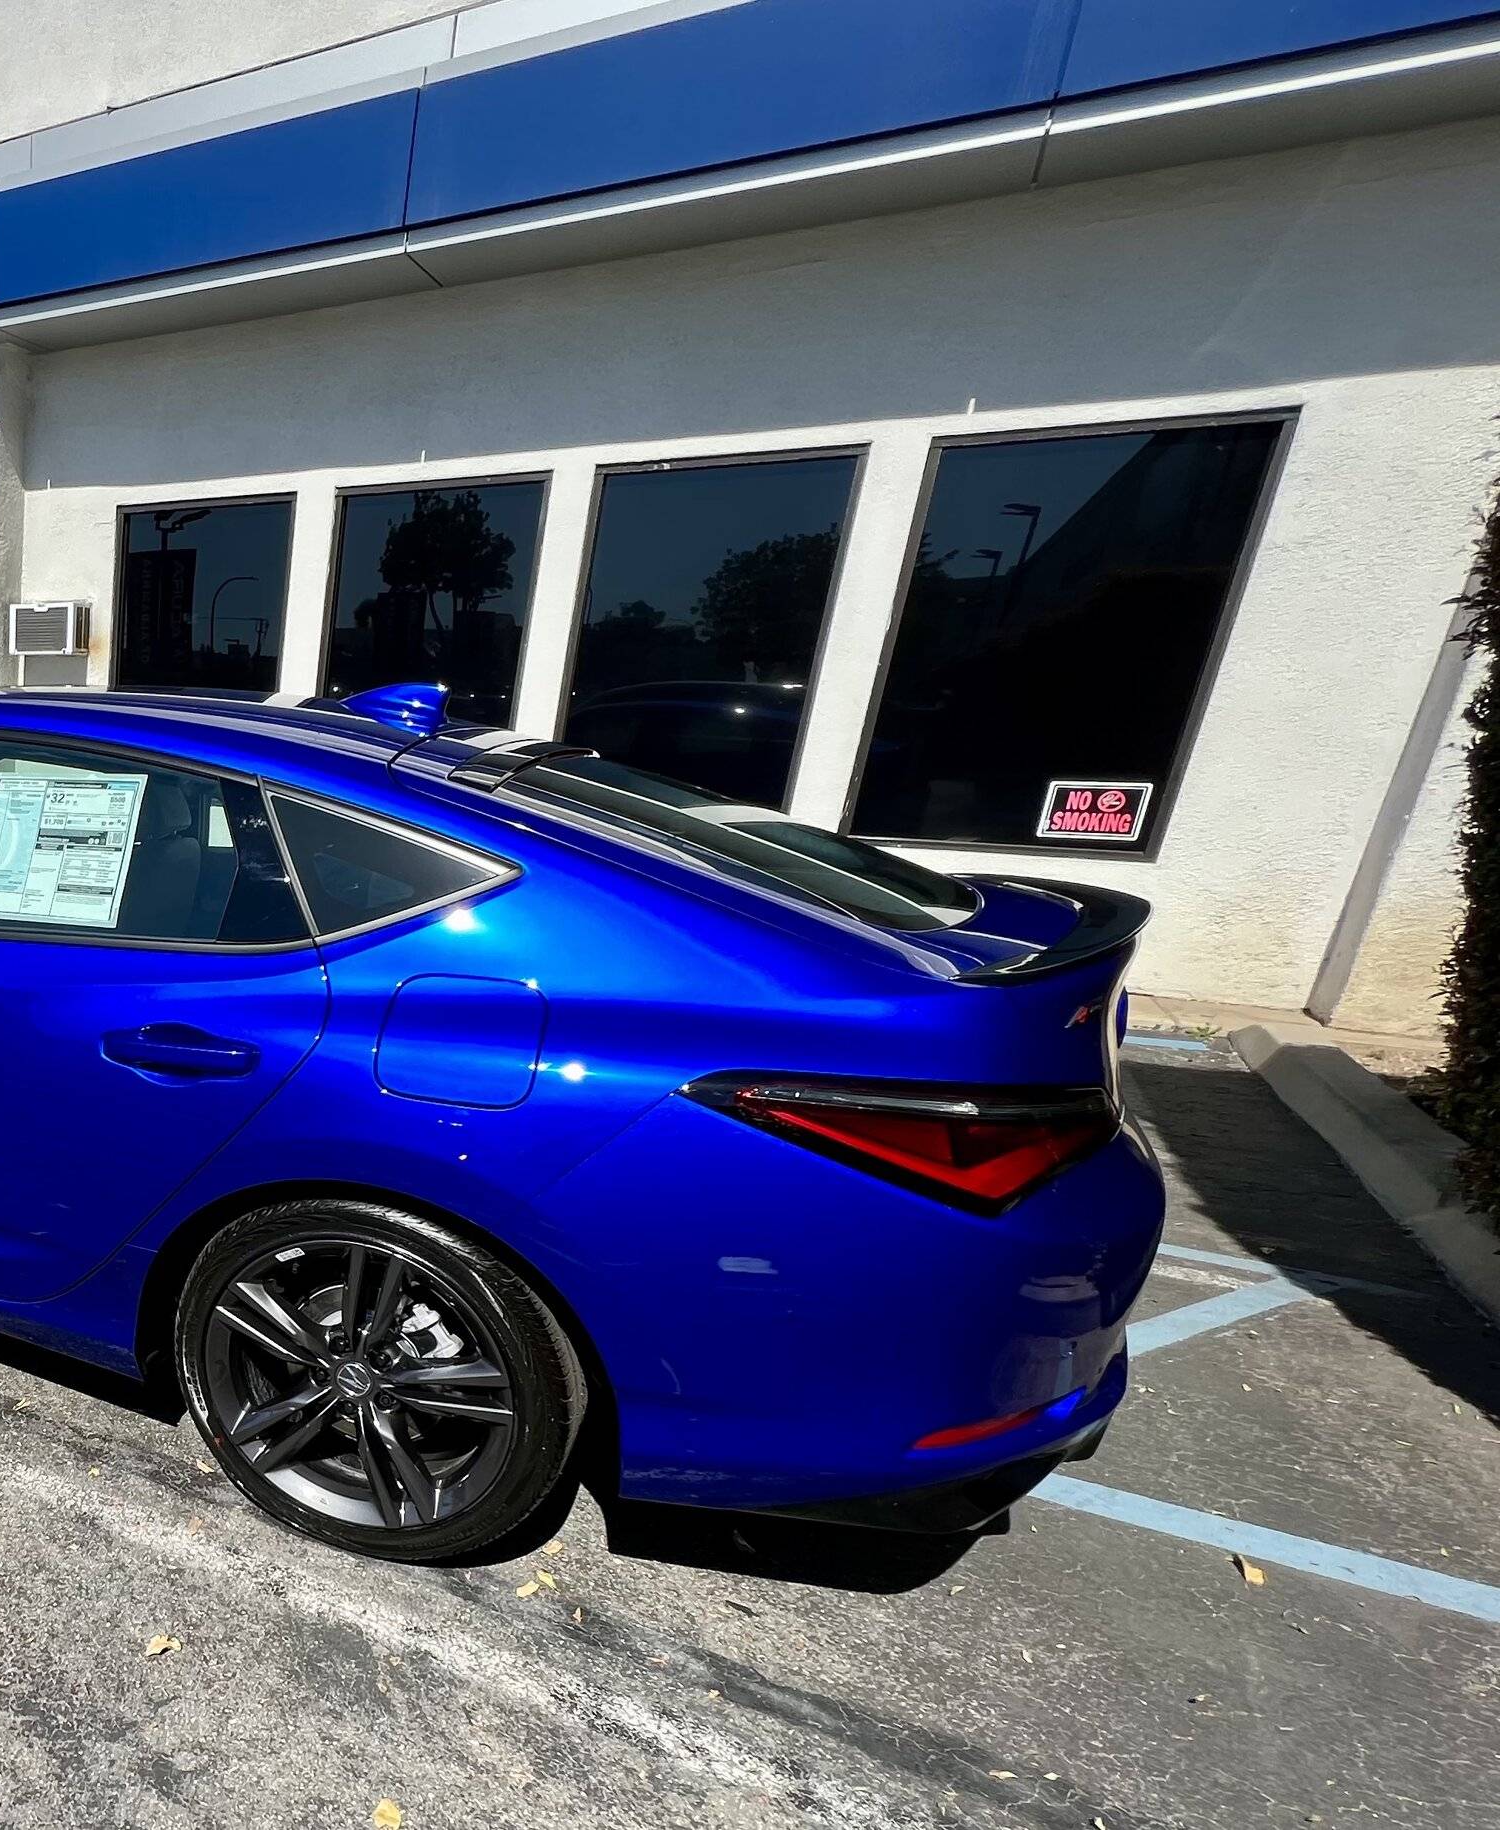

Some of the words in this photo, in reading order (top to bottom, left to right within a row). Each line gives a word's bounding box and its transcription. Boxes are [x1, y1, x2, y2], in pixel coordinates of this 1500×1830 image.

[50, 792, 66, 804] 32
[1065, 790, 1093, 811] NO
[1050, 811, 1132, 833] SMOKING
